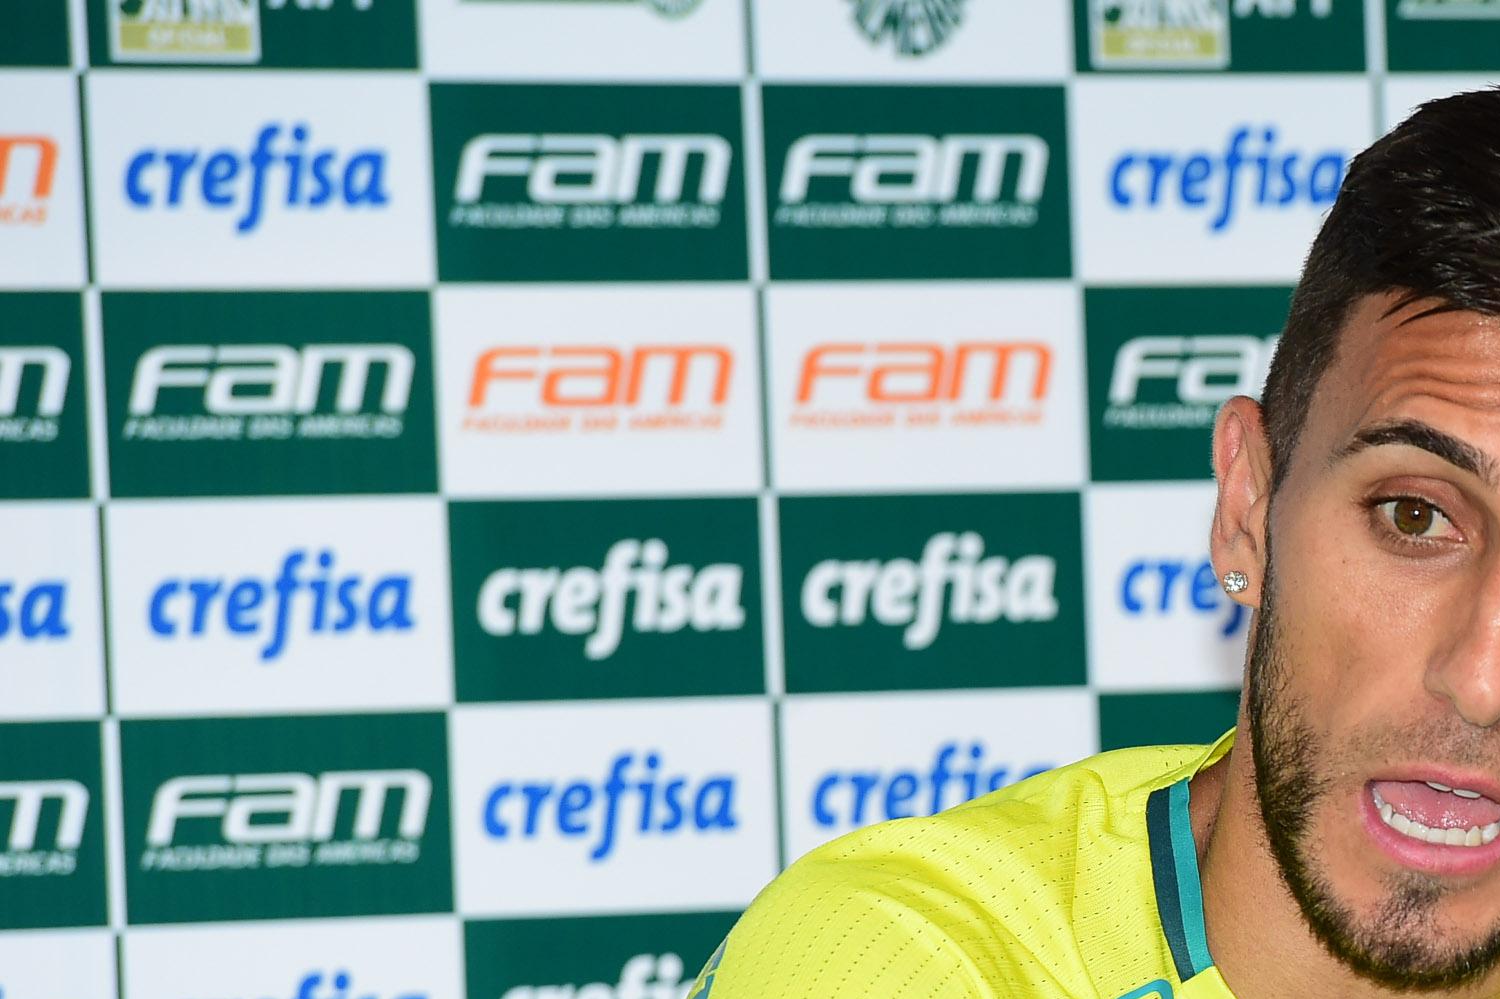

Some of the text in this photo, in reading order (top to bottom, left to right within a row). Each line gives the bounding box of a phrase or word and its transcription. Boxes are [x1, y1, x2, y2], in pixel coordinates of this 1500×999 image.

[124, 123, 389, 234] crefisa
[1107, 124, 1347, 231] crefisa
[148, 550, 415, 662] crefisa
[477, 539, 745, 659] crefisa
[801, 532, 1058, 649] crefisa
[482, 752, 739, 862] crefisa
